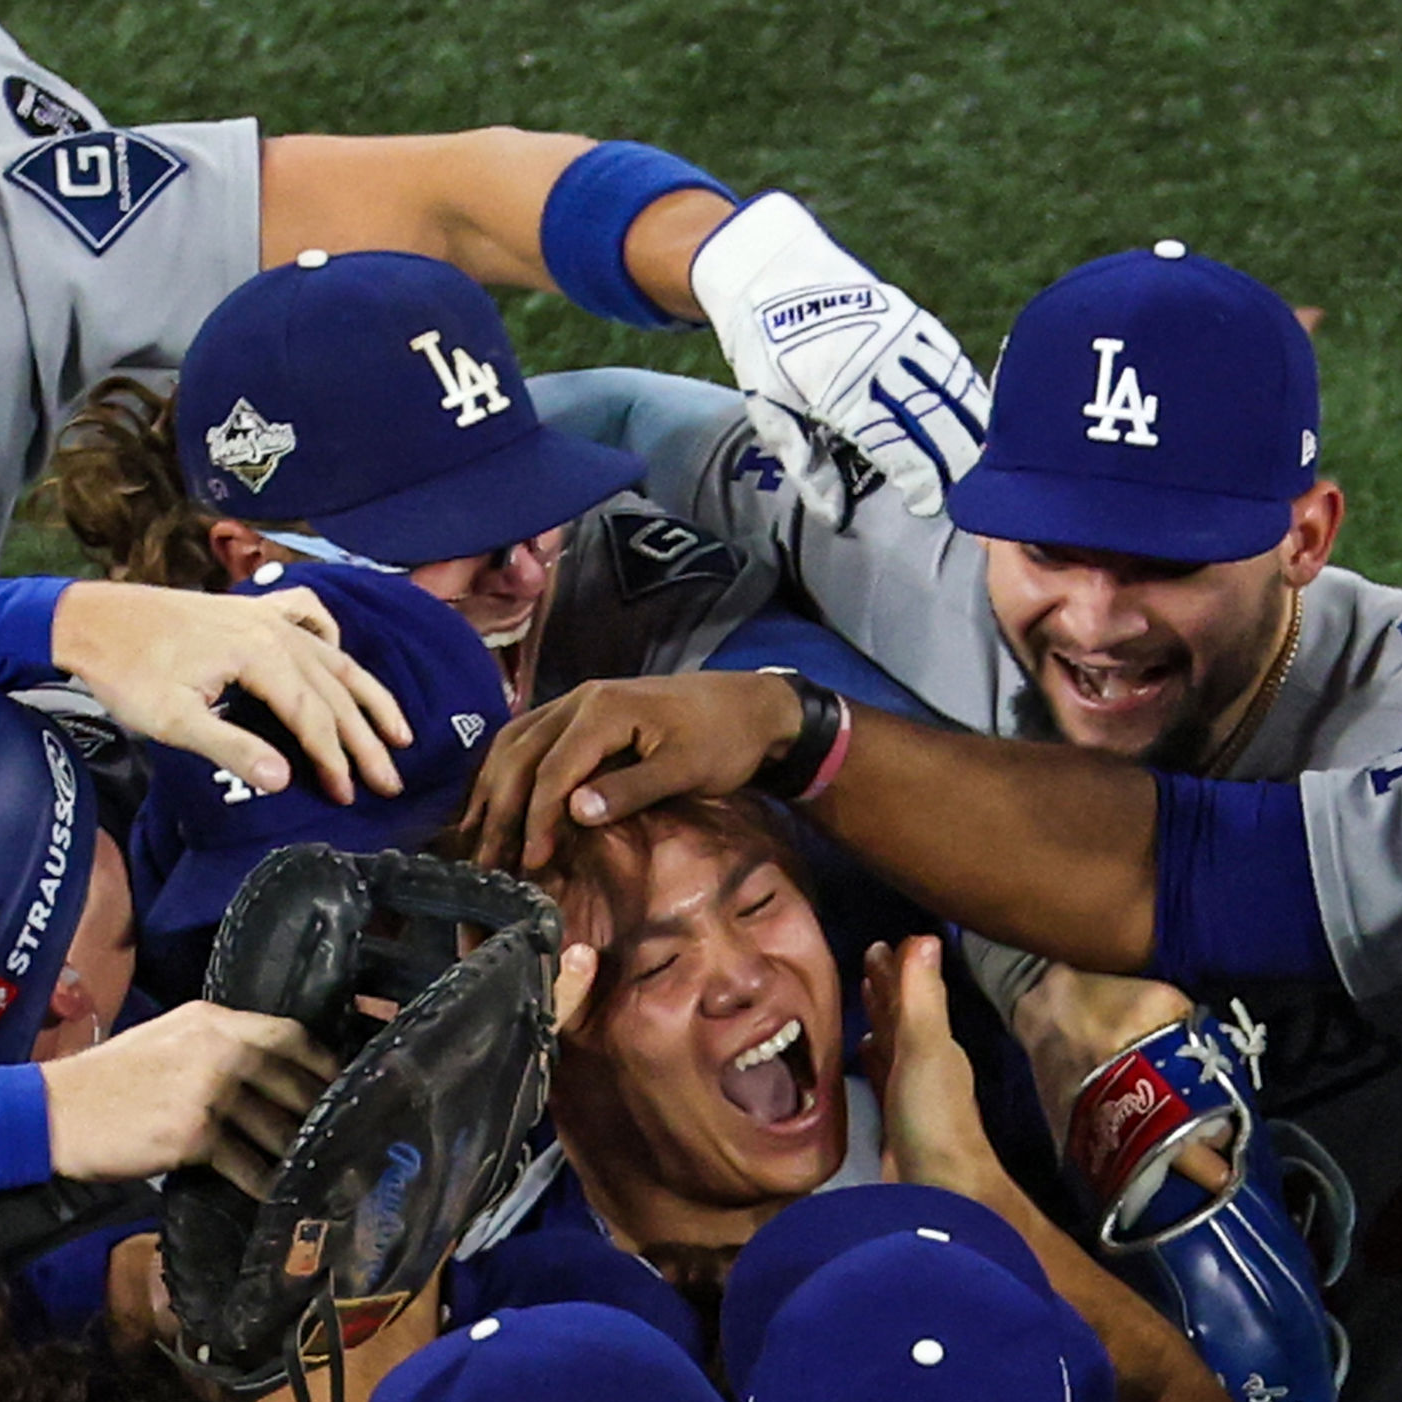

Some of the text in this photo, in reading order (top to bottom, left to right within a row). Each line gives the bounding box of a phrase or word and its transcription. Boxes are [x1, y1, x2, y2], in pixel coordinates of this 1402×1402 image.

[772, 289, 873, 330] franklin
[409, 330, 511, 427] LA
[1083, 337, 1159, 446] LA
[7, 797, 77, 977] STRAUSS
